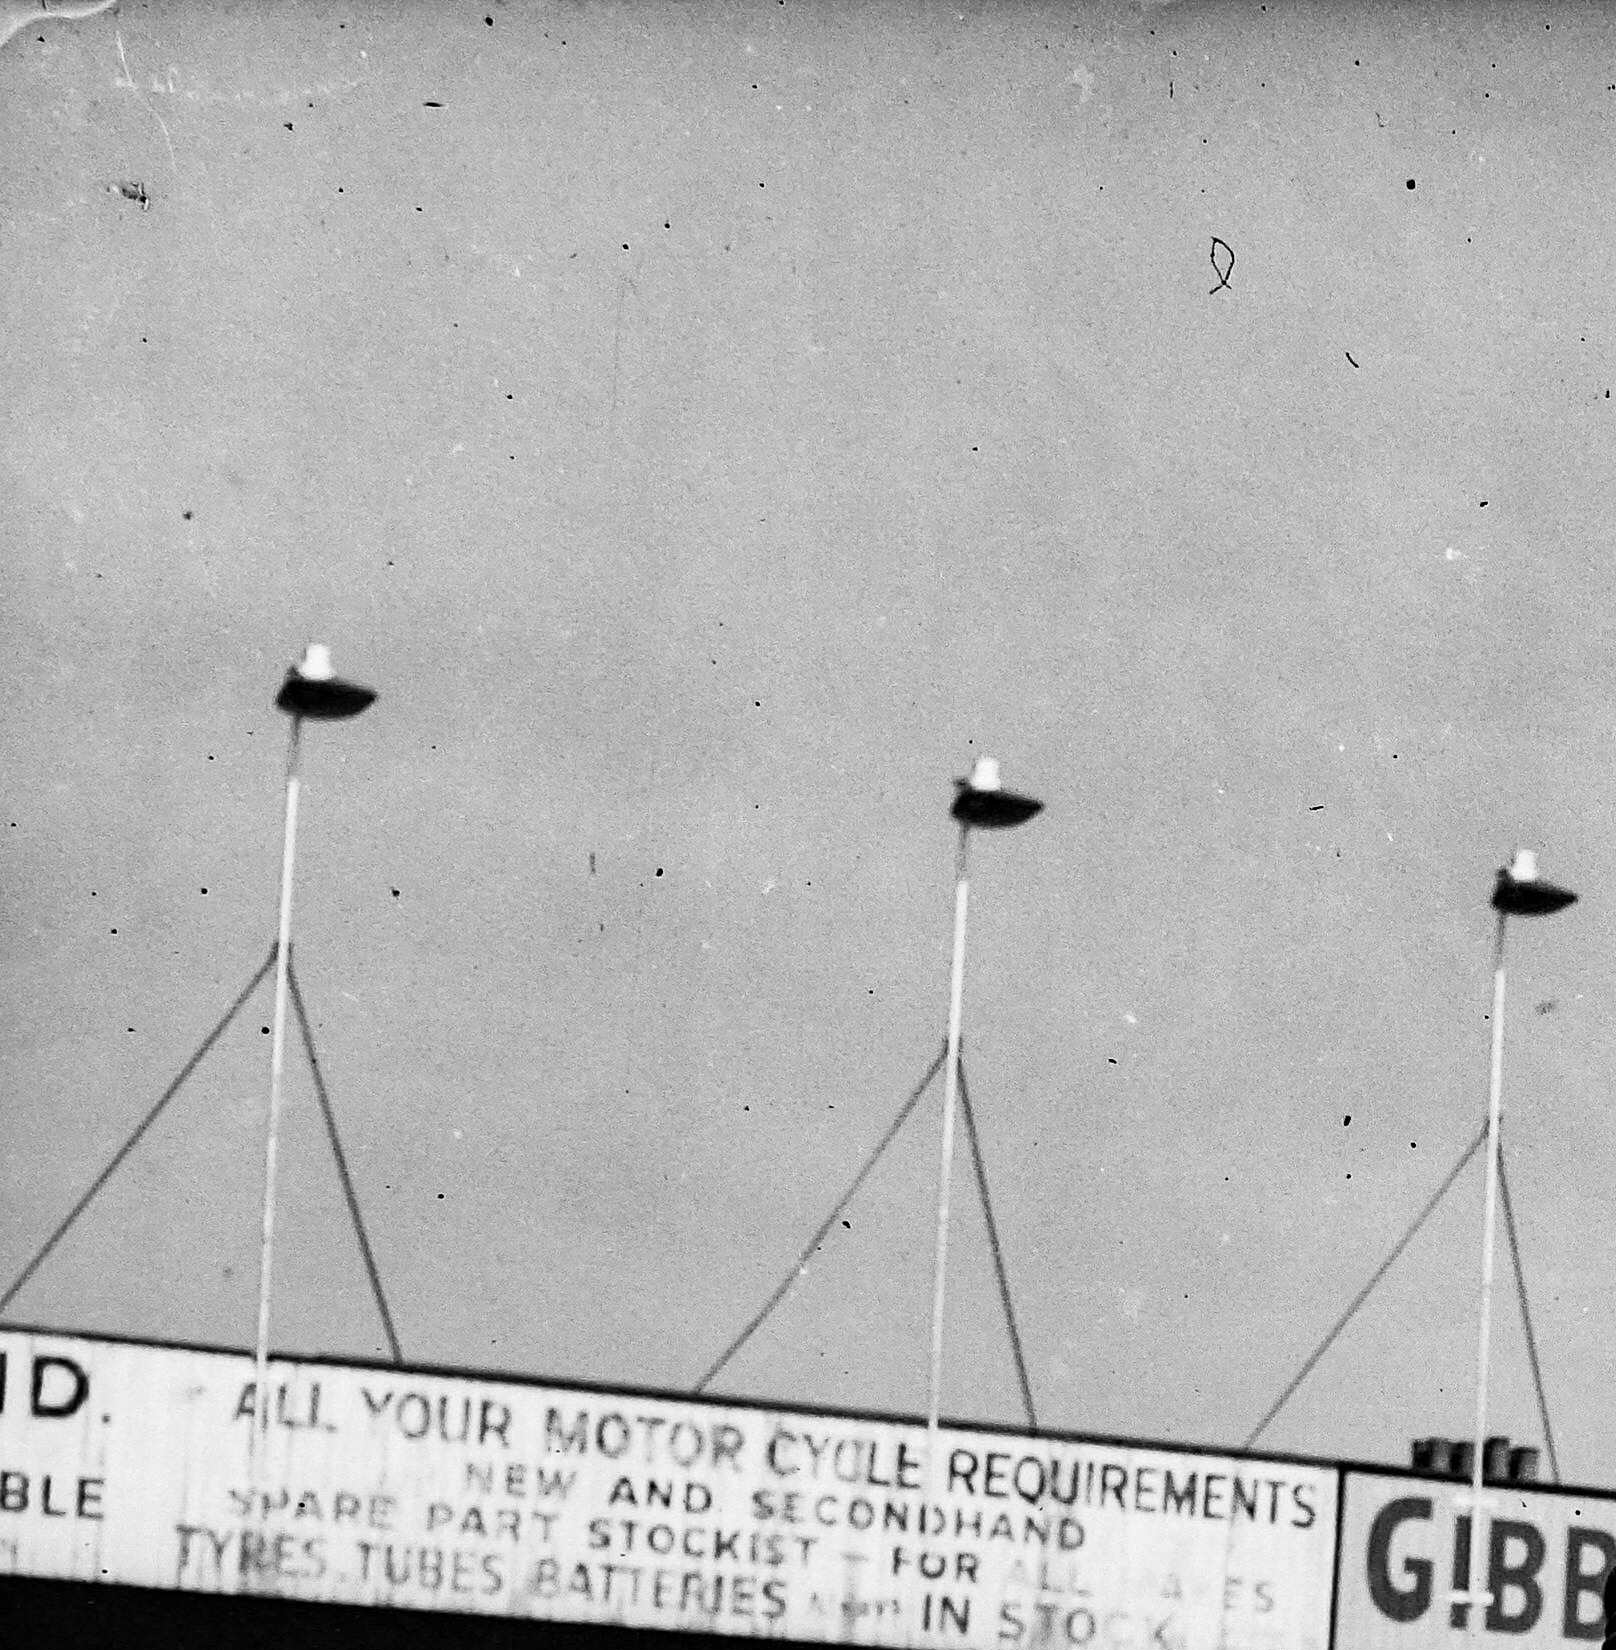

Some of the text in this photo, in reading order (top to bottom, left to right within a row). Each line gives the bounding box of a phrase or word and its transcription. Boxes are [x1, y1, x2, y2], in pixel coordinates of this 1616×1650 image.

[233, 1382, 1318, 1530] ALL YOUR MOTOR CYCLE REQUIREMENTS
[228, 1487, 396, 1532] SPARE
[426, 1501, 561, 1544] PART
[588, 1517, 818, 1571] STOCKIST
[892, 1545, 980, 1584] FOR
[466, 1462, 1086, 1552] NEW AND SECONDHAND
[356, 1540, 503, 1595] TUBES
[533, 1556, 787, 1619] BATTERIES
[921, 1593, 971, 1635] IN
